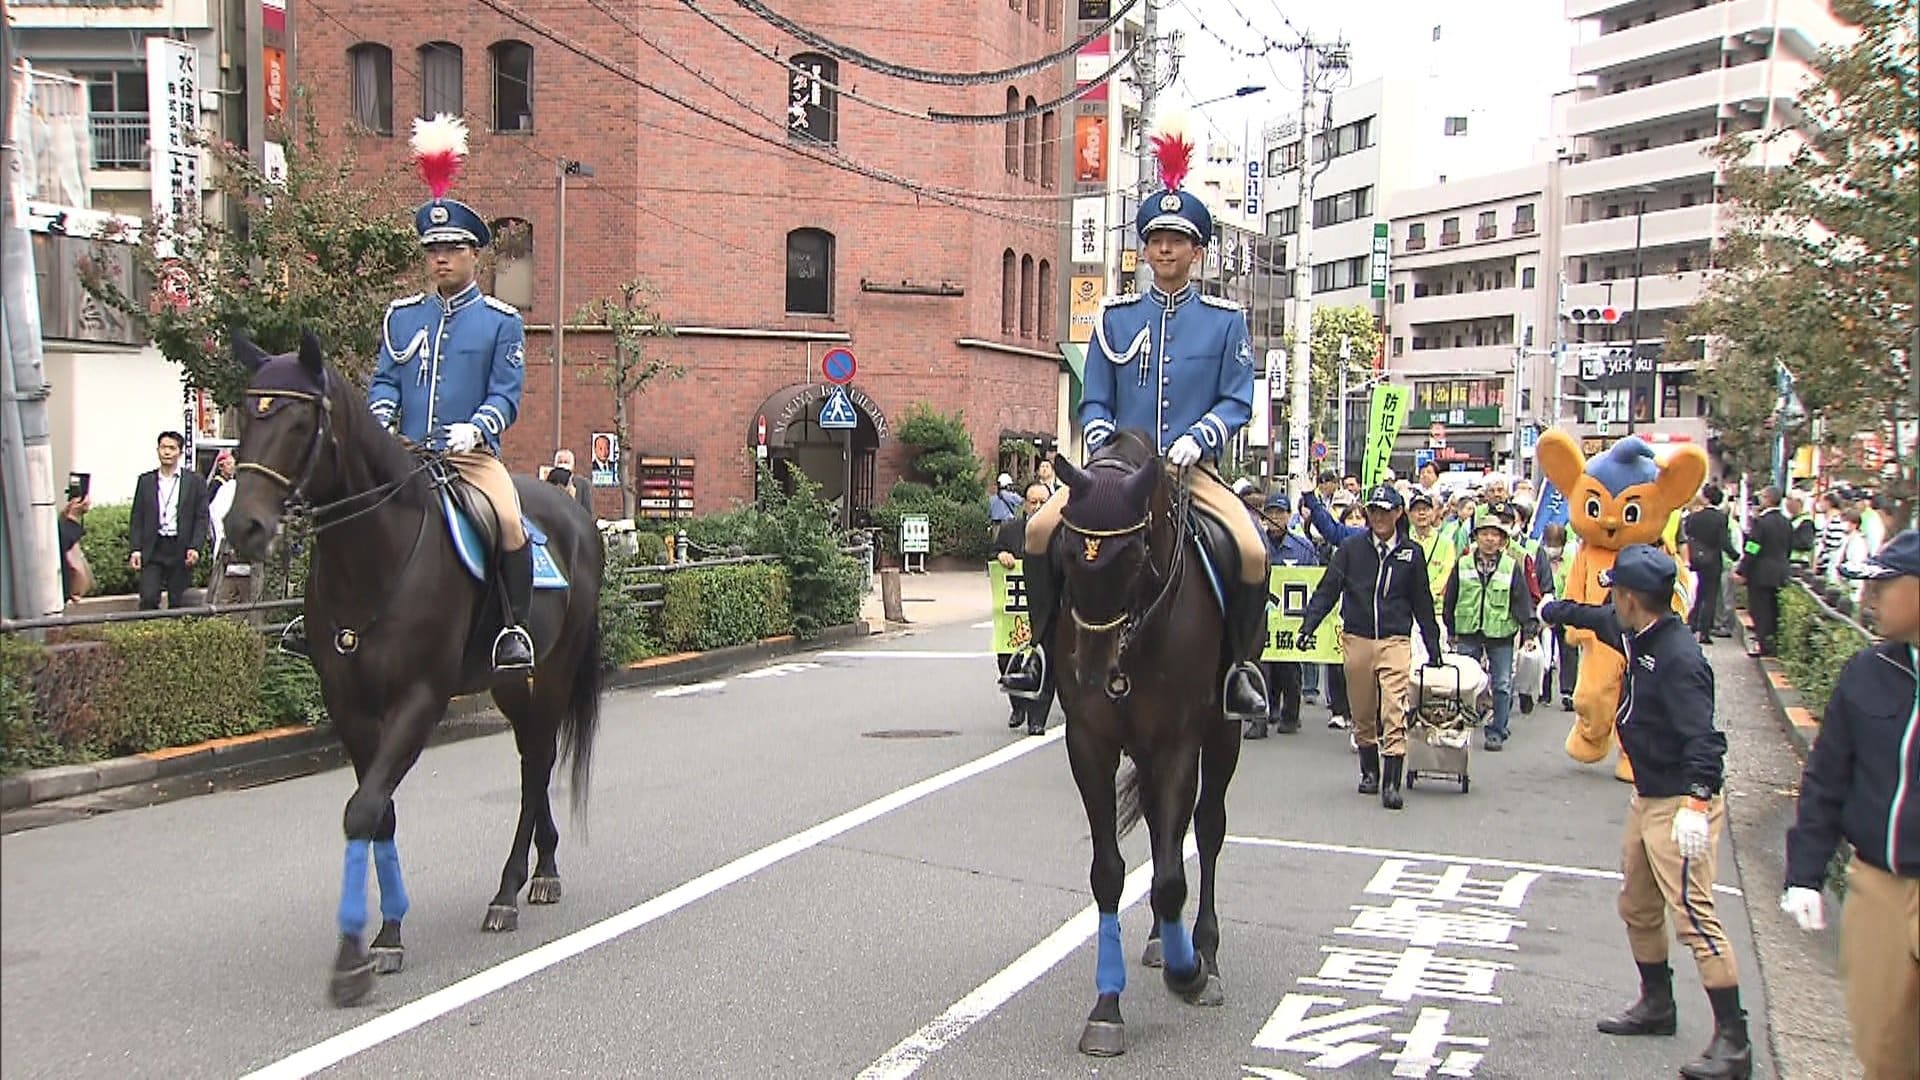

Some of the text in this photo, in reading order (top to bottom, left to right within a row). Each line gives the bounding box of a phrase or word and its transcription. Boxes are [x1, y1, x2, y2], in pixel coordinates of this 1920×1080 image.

[1247, 161, 1259, 214] ena
[850, 389, 889, 438] UILDING
[1241, 859, 1542, 1080] 物車専用
